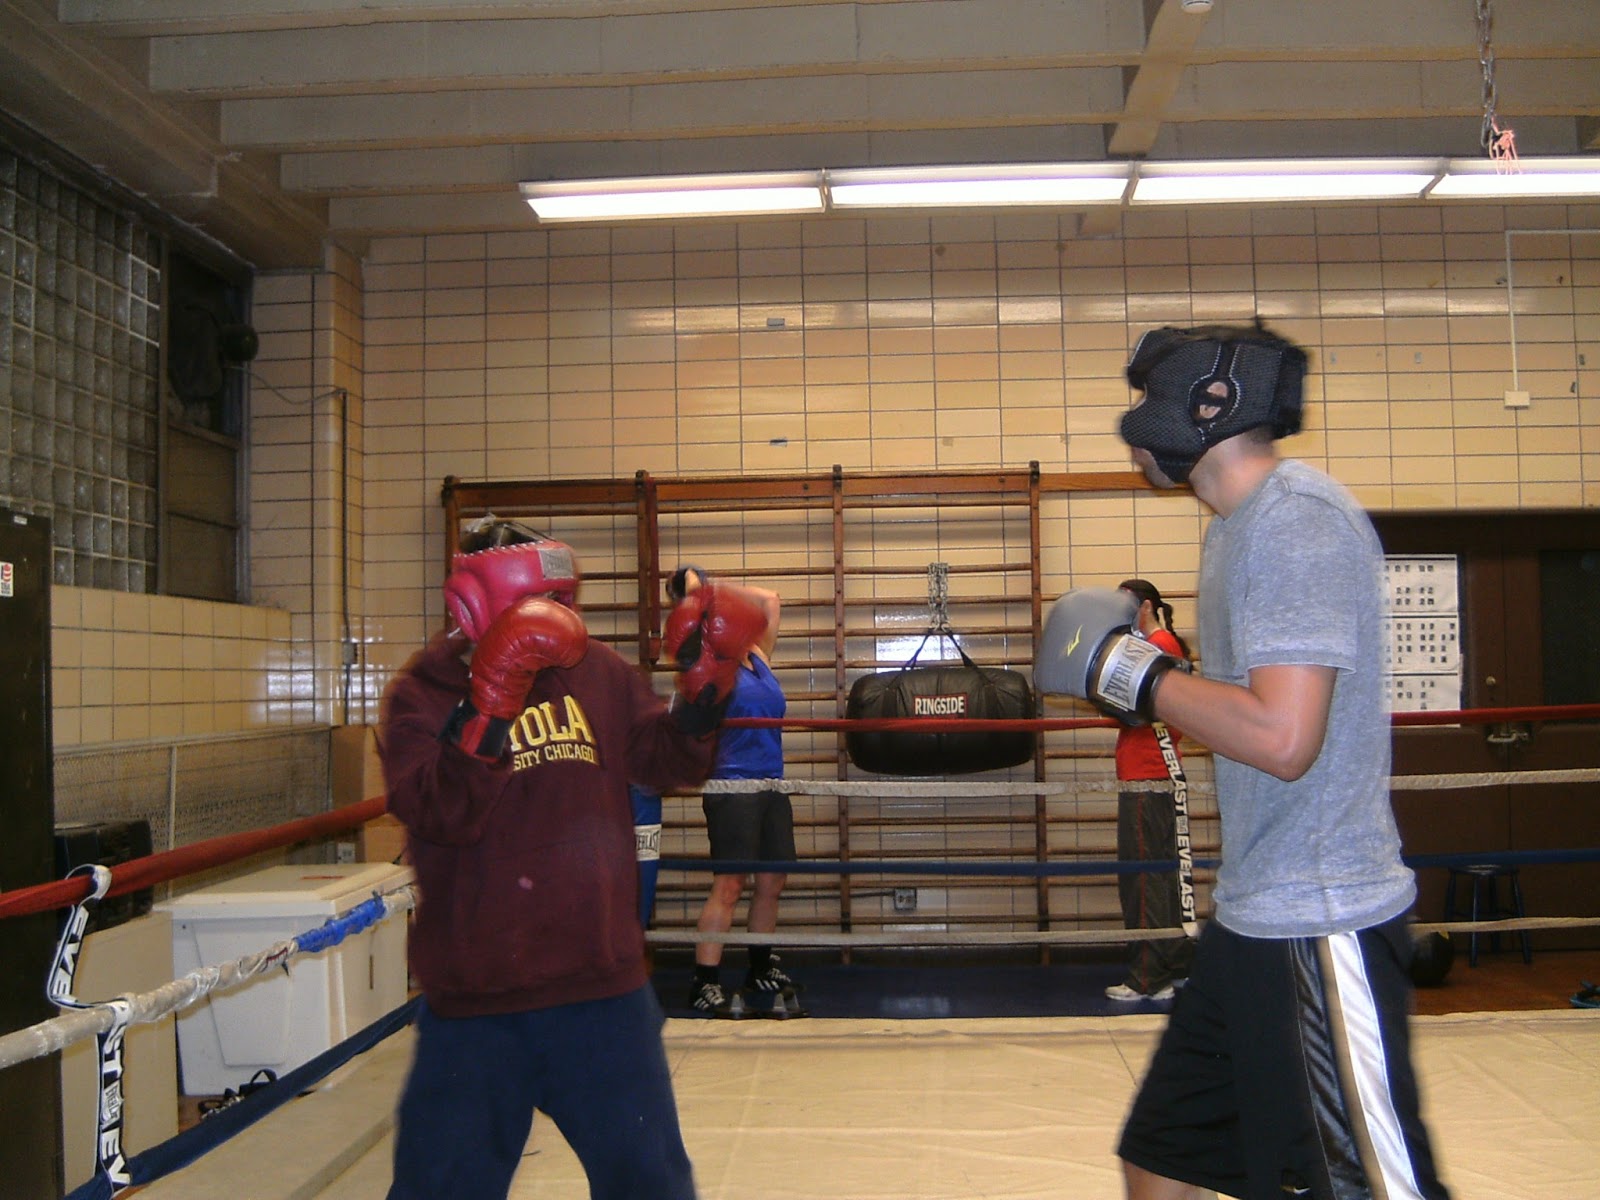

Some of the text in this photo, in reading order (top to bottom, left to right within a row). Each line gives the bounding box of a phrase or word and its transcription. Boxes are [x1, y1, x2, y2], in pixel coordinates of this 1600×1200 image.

[1103, 637, 1157, 705] EVERLAST
[914, 696, 965, 715] RINGSIDE
[513, 744, 598, 771] SITY CHICAGO
[1156, 727, 1187, 815] EVERLAST
[1177, 835, 1195, 921] EVELAST
